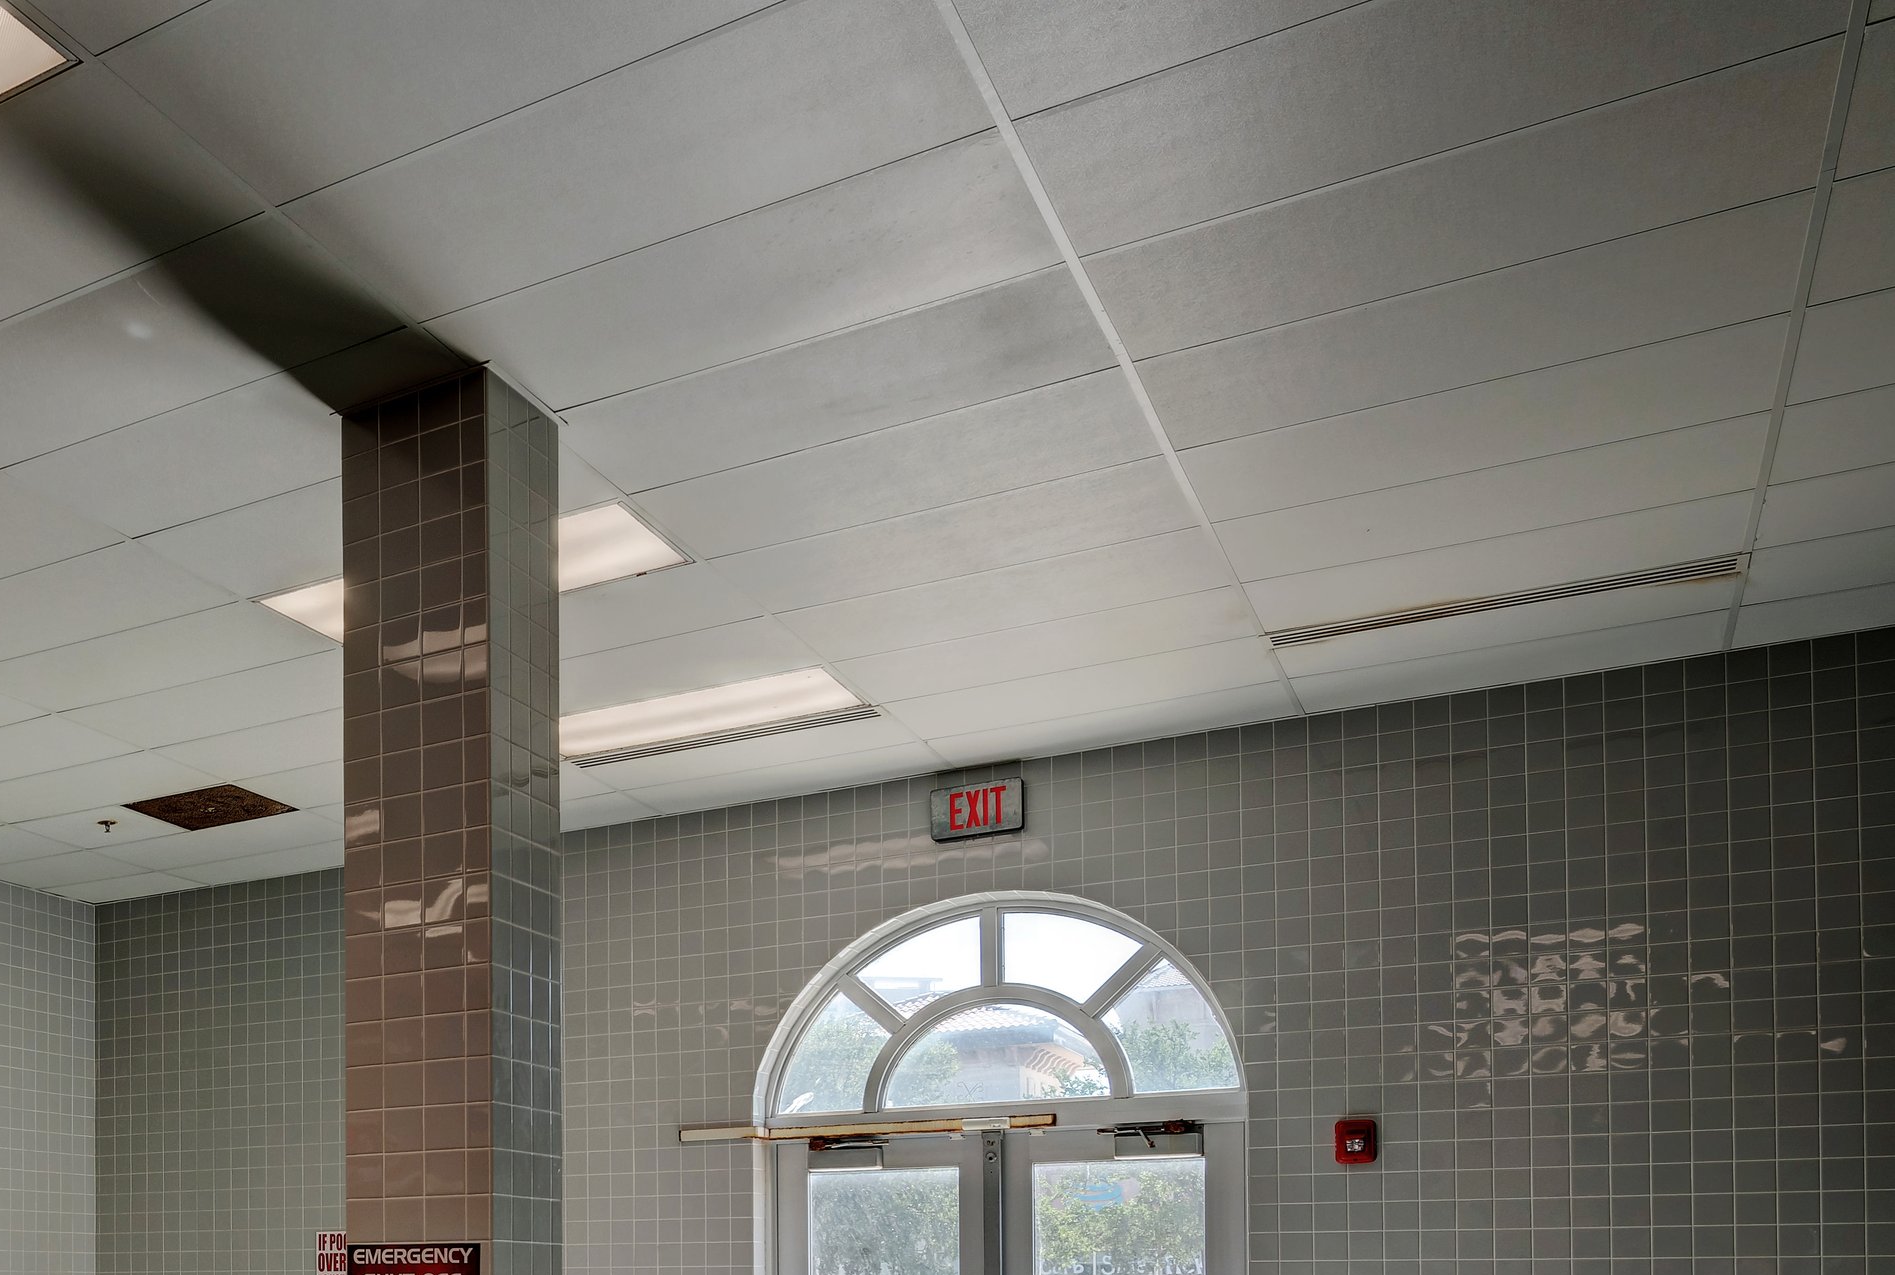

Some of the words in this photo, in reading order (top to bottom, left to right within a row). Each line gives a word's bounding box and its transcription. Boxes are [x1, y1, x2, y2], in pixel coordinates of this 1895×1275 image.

[949, 785, 1007, 831] EXIT
[318, 1233, 327, 1251] IF
[353, 1247, 473, 1265] EMERGENCY
